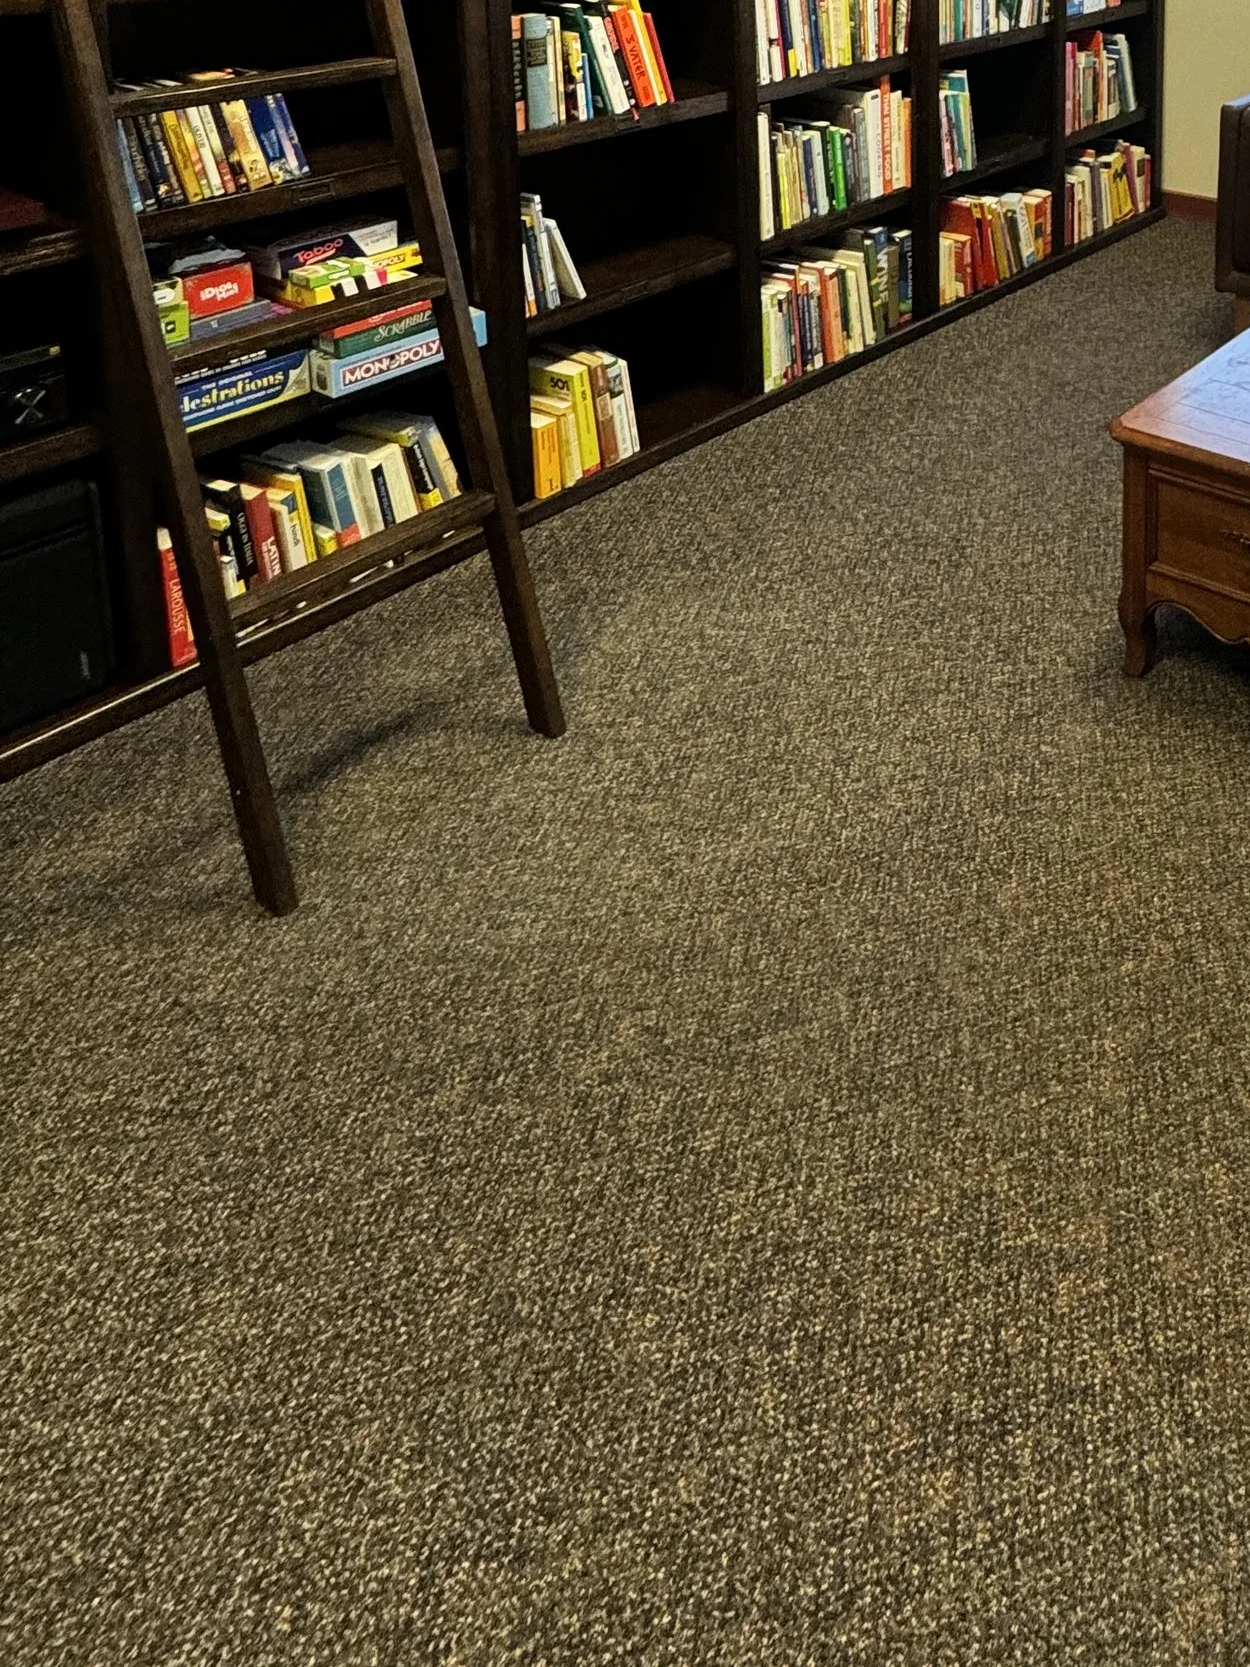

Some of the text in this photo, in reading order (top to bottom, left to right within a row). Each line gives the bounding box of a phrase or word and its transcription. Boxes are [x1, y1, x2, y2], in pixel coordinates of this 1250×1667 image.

[293, 238, 344, 264] Taboo
[344, 339, 440, 385] MONOPOLY
[180, 370, 285, 413] lestrations
[550, 376, 570, 391] 501
[266, 535, 282, 577] LATIN
[169, 577, 186, 634] LAROUSSE
